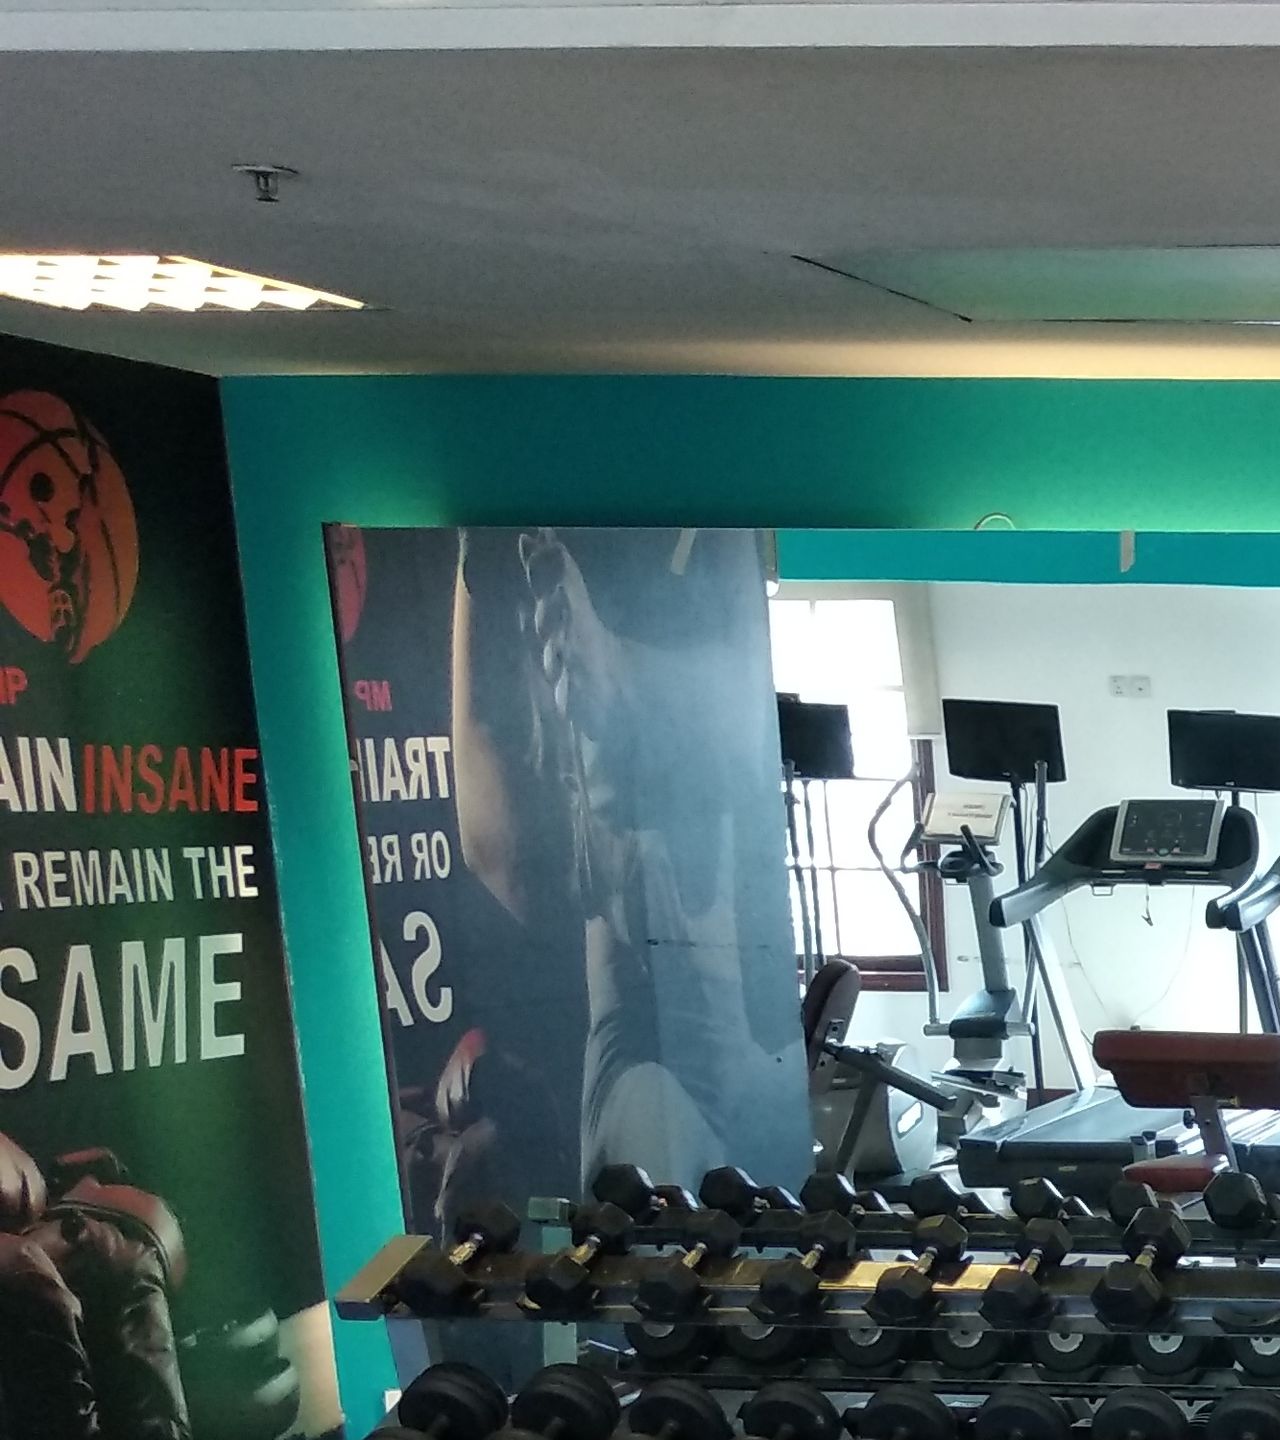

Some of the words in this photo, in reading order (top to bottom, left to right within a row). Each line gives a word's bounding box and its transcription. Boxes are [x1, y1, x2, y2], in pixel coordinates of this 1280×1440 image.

[84, 744, 259, 814] INSANE
[13, 846, 174, 910] REMAIN
[183, 845, 259, 899] THE
[0, 932, 245, 1090] SAME
